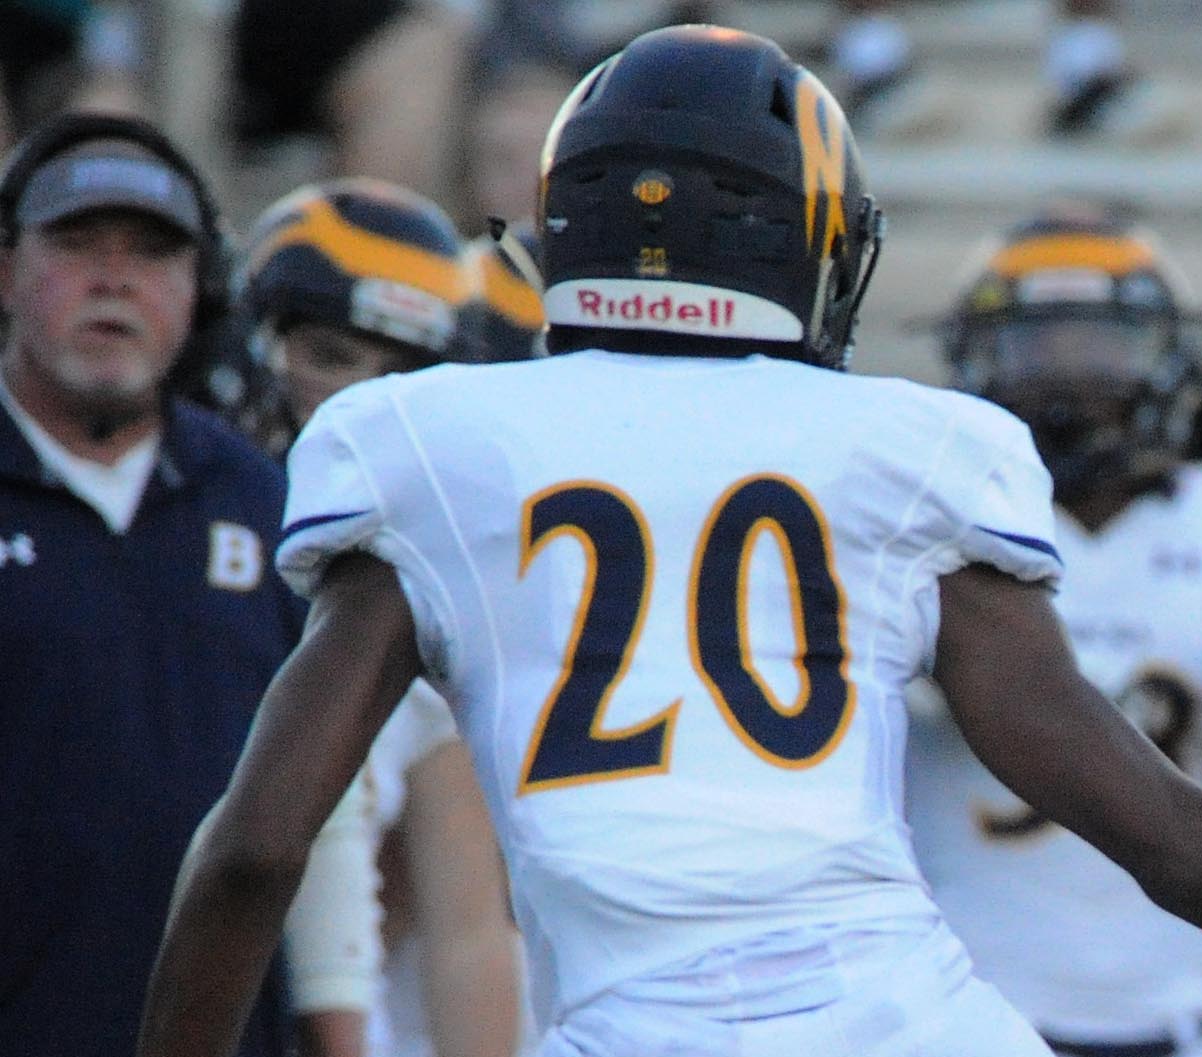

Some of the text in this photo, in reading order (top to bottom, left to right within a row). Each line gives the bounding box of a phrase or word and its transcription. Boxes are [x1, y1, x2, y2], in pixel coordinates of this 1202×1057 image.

[576, 289, 736, 327] Riddell
[208, 521, 263, 591] B
[515, 471, 858, 798] 20
